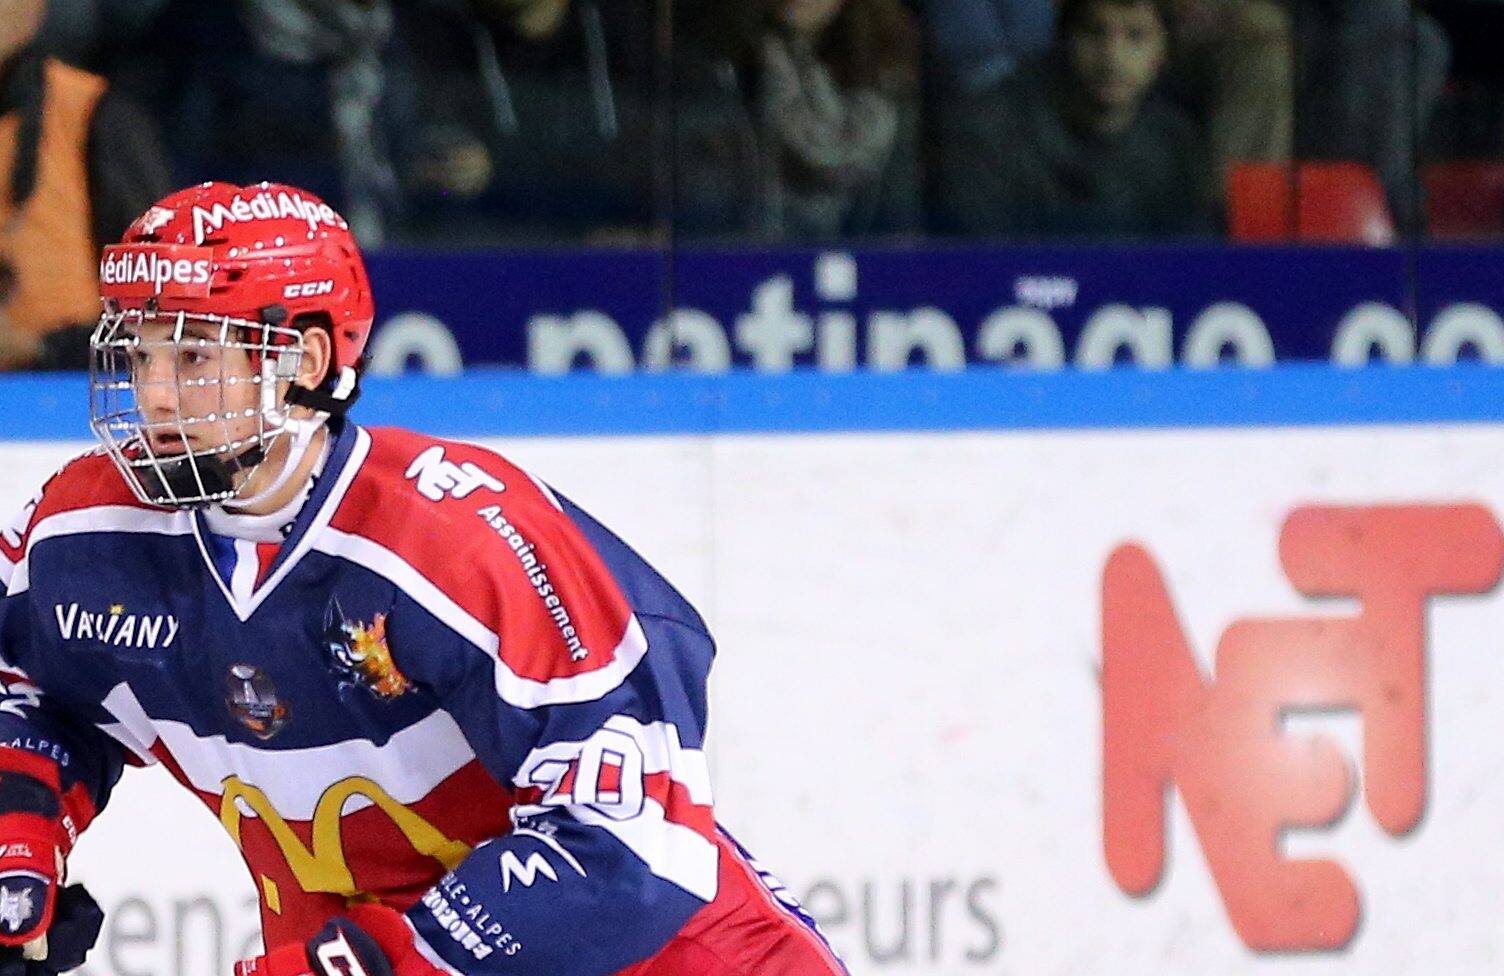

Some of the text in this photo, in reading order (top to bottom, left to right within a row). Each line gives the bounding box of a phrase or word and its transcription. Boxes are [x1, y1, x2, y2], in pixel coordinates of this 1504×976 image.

[100, 252, 210, 295] édiAlpes
[283, 280, 334, 298] CCM
[403, 444, 507, 502] NET
[476, 503, 590, 662] Assainissement
[1097, 502, 1504, 953] NET
[802, 875, 1004, 966] eurs
